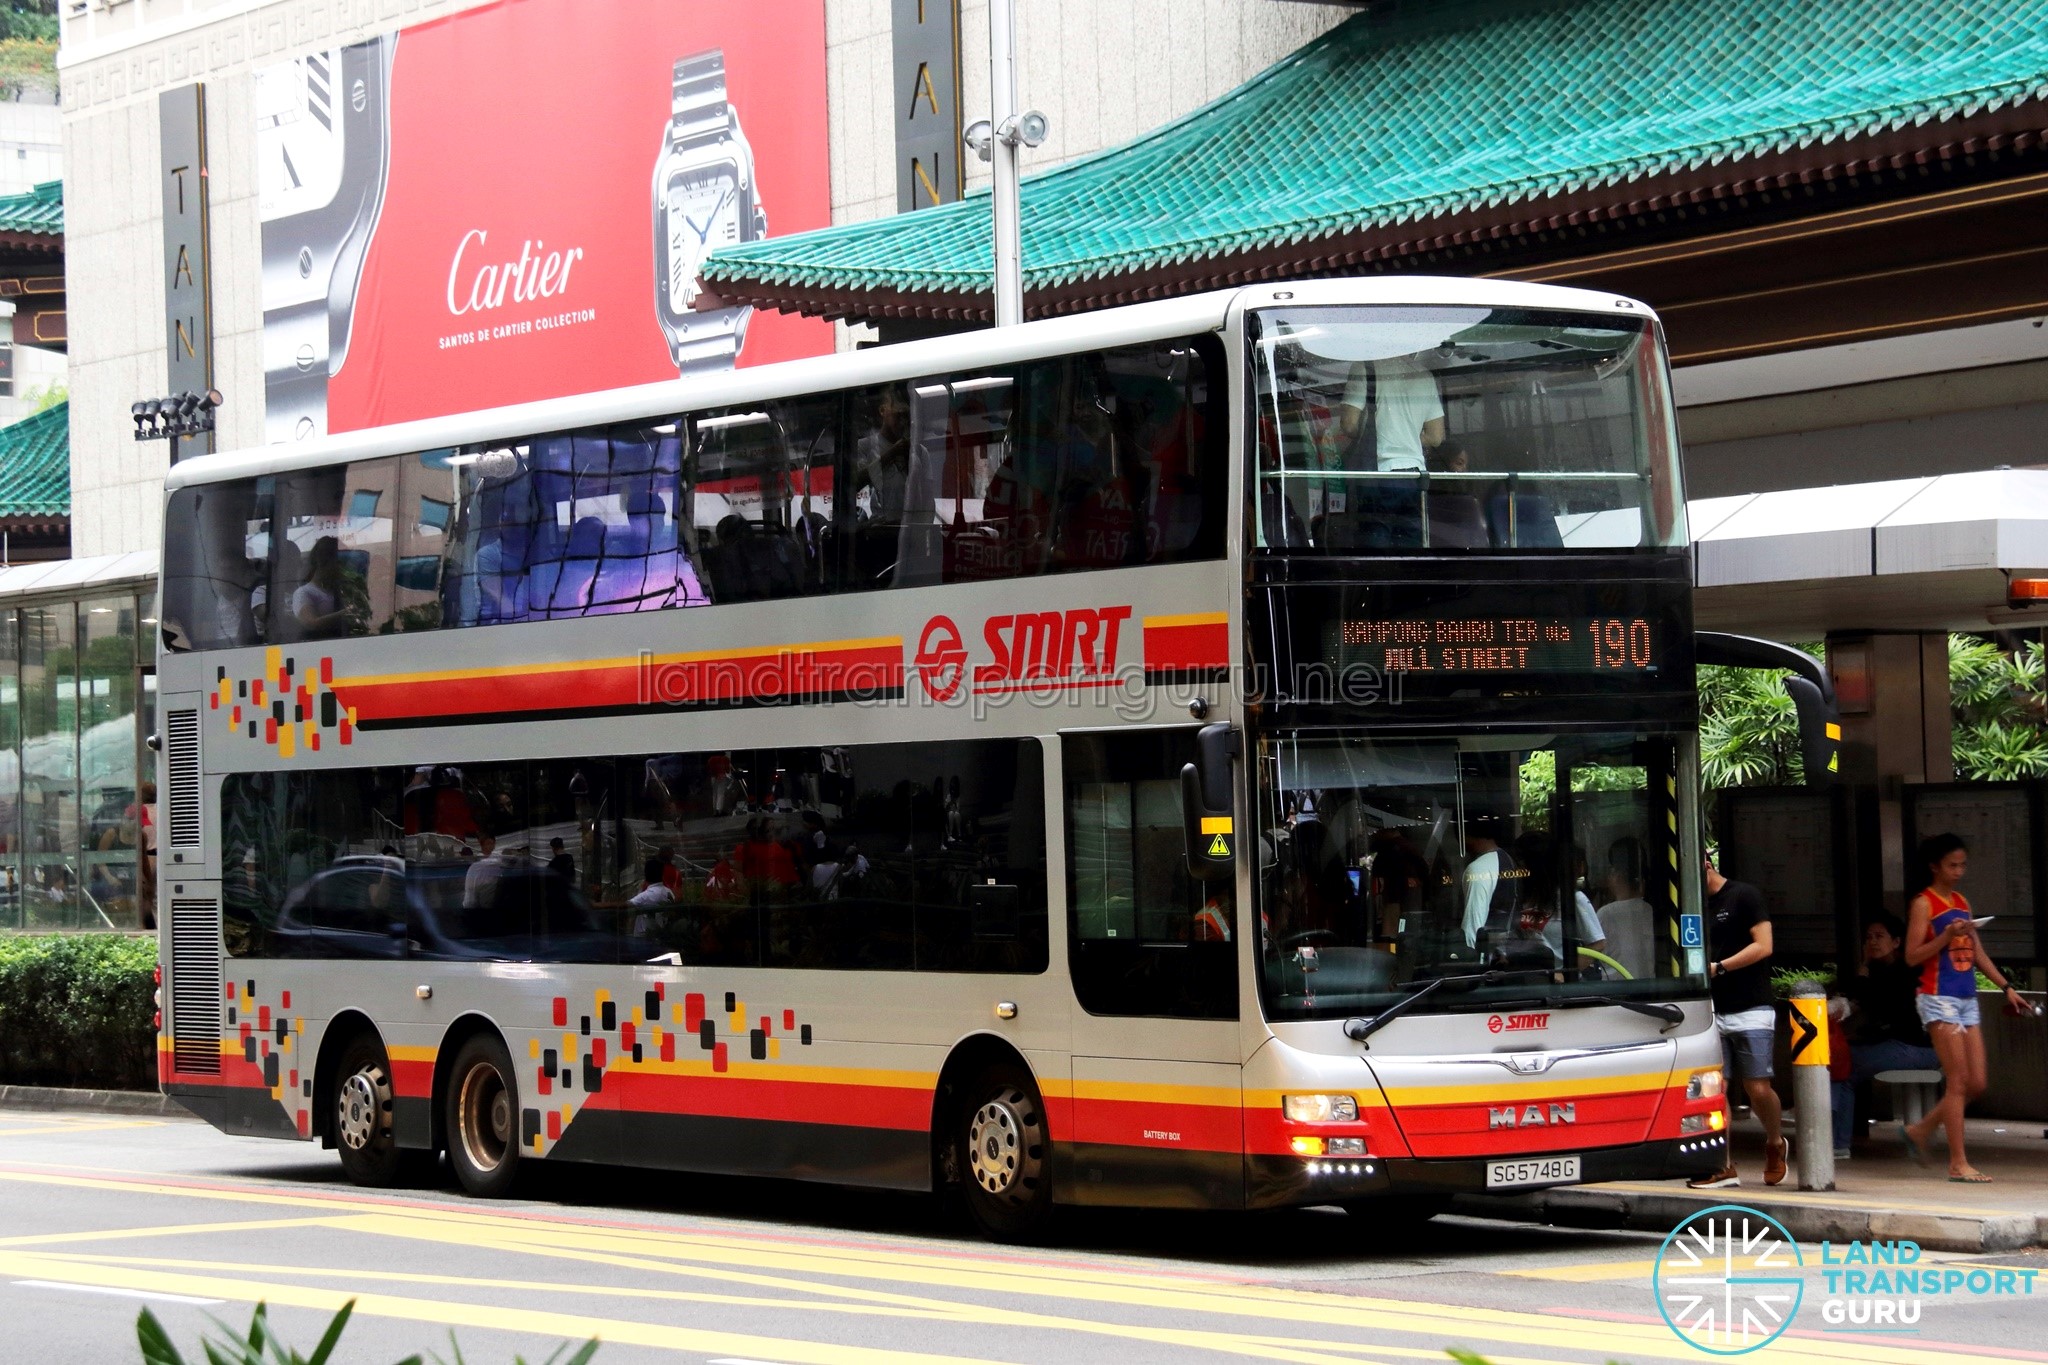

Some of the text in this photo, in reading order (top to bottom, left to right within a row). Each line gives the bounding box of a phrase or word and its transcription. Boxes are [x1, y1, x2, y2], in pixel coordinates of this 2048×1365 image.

[171, 165, 195, 362] TAN
[447, 228, 584, 316] Cartier
[438, 308, 596, 350] SANTOS DE CARTIER COLLECTION
[972, 605, 1133, 682] SMRT
[1342, 620, 1570, 643] KAMPONG BAHRU TER via
[1588, 618, 1651, 668] 190
[1442, 647, 1529, 670] STREET
[1506, 1013, 1551, 1030] SMRT
[1488, 1102, 1576, 1129] MAN
[1143, 1129, 1181, 1141] BATTERY BOX
[1493, 1160, 1574, 1183] SG5748G
